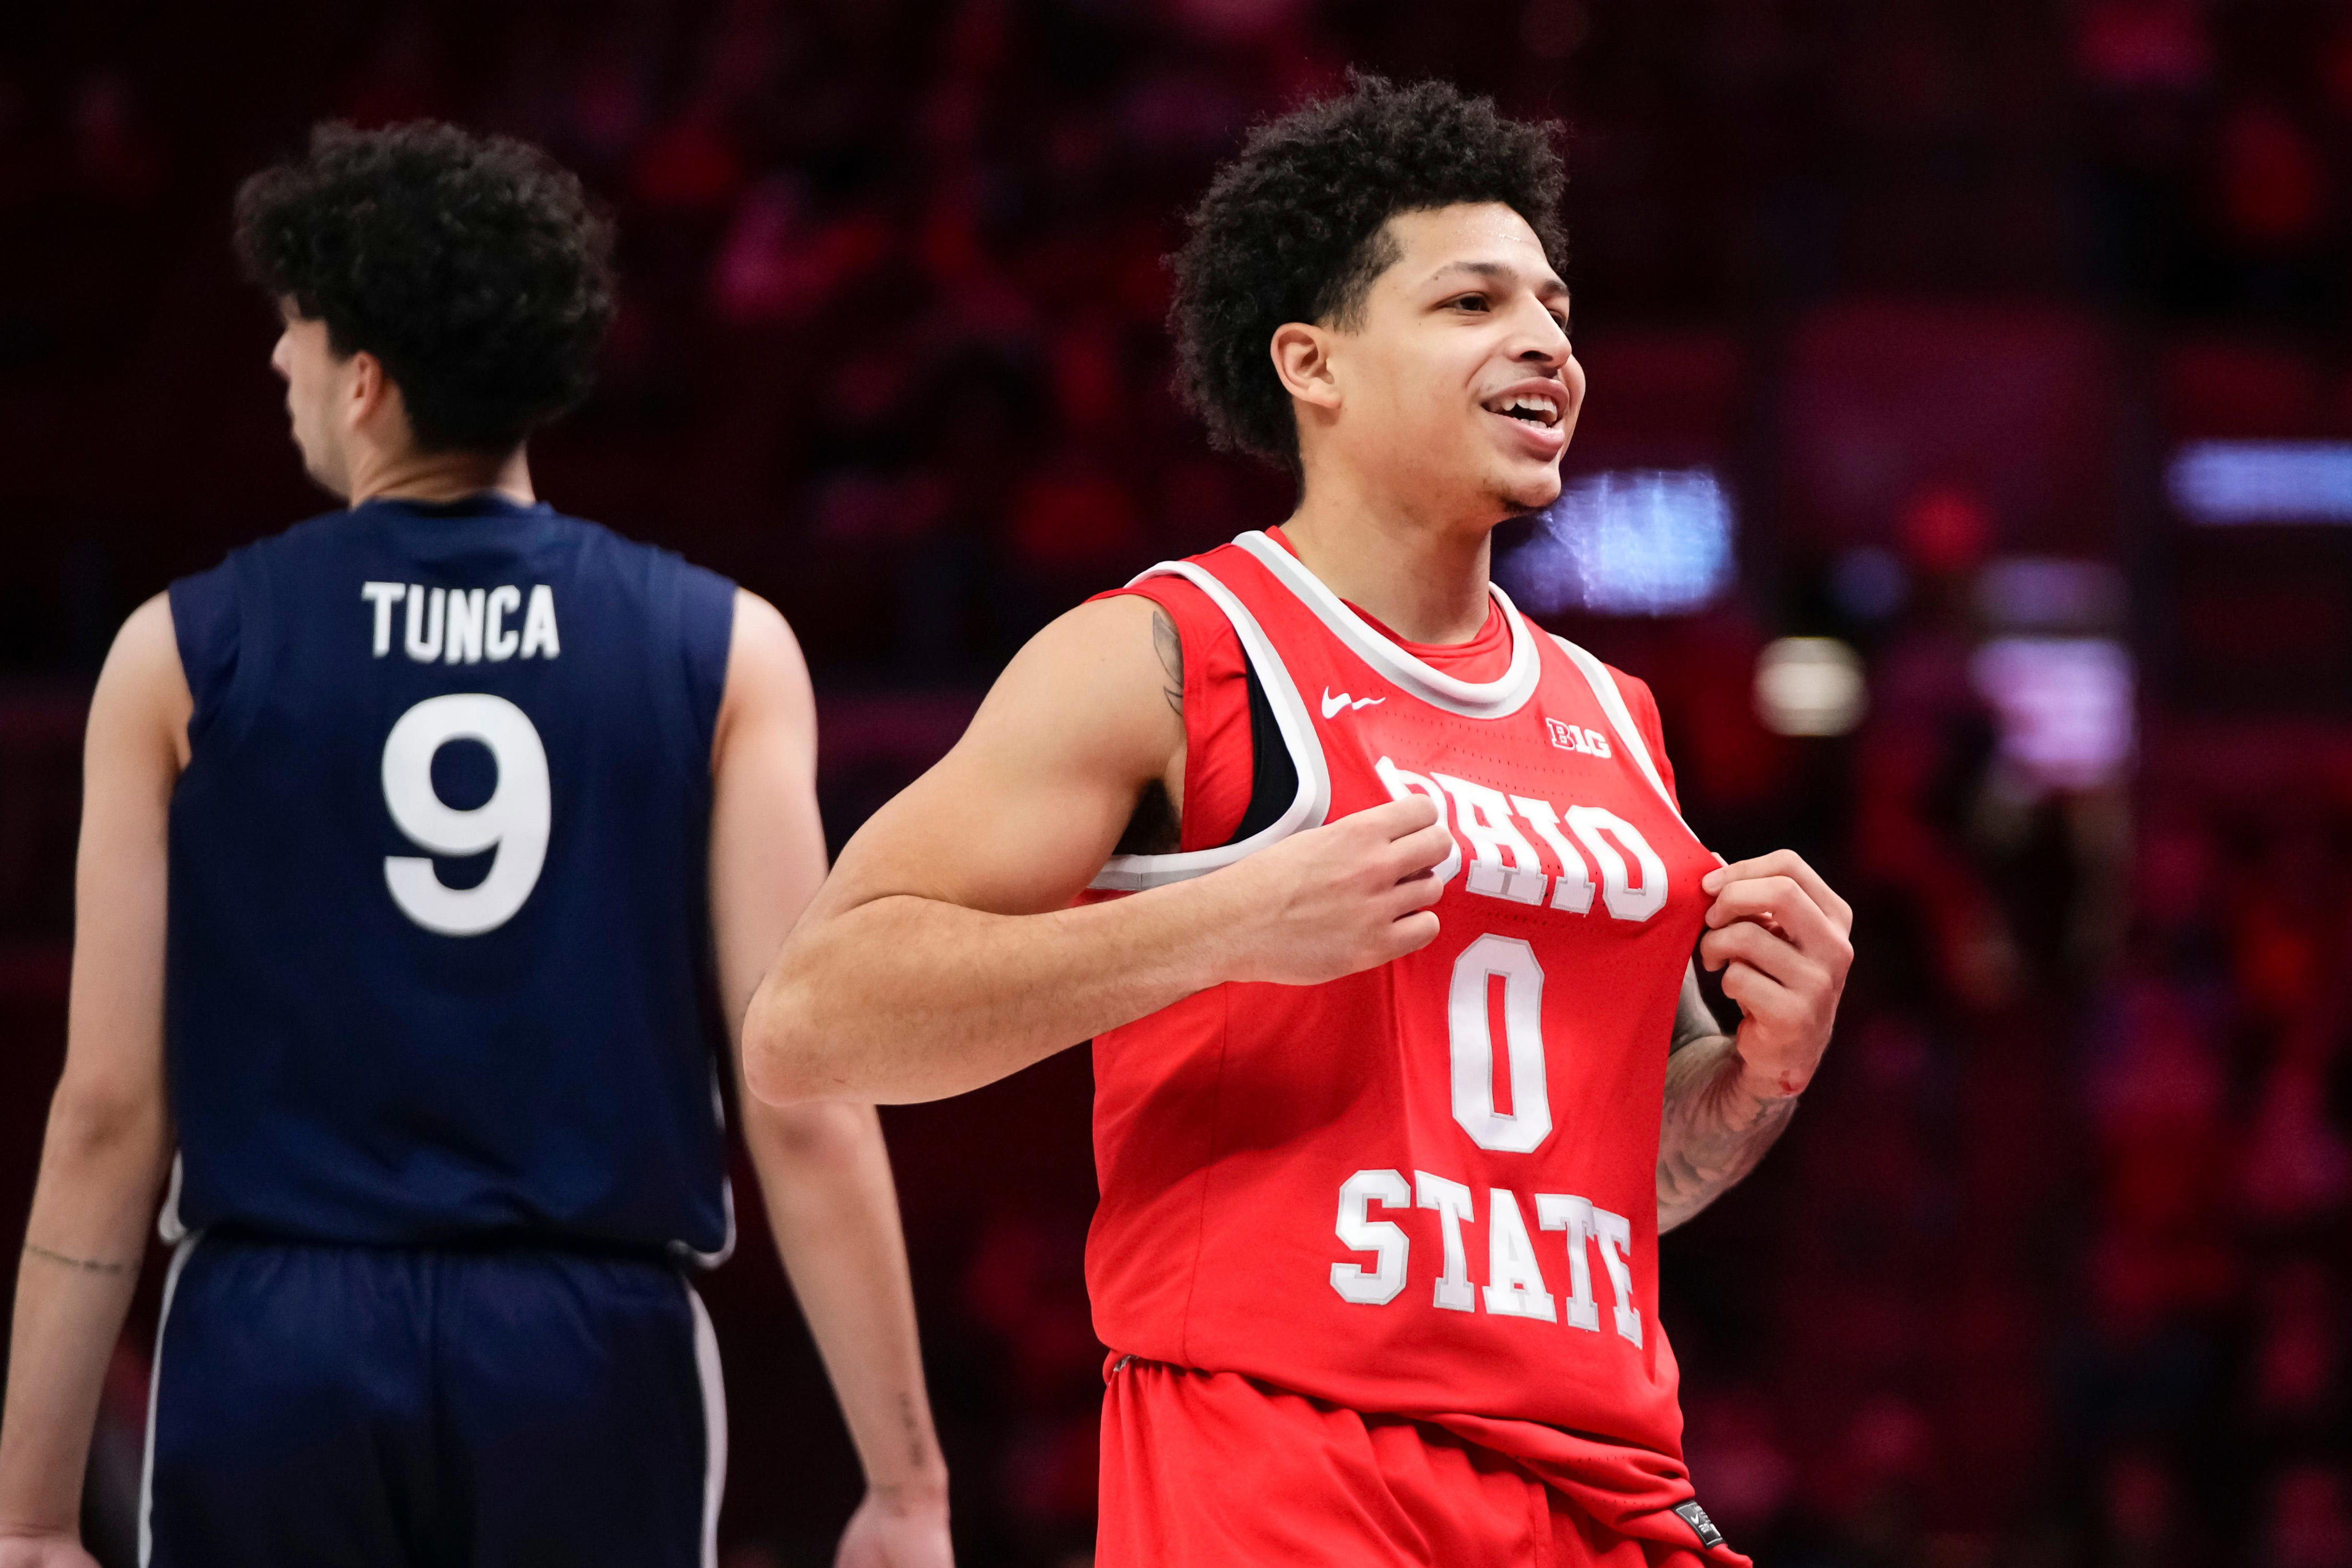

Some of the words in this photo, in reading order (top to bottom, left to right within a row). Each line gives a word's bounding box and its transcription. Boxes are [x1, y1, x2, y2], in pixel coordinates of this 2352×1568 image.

[362, 581, 560, 664] TUNCA
[381, 693, 551, 937] 9
[1449, 933, 1553, 1153] 0
[1330, 1169, 1643, 1349] STATE
